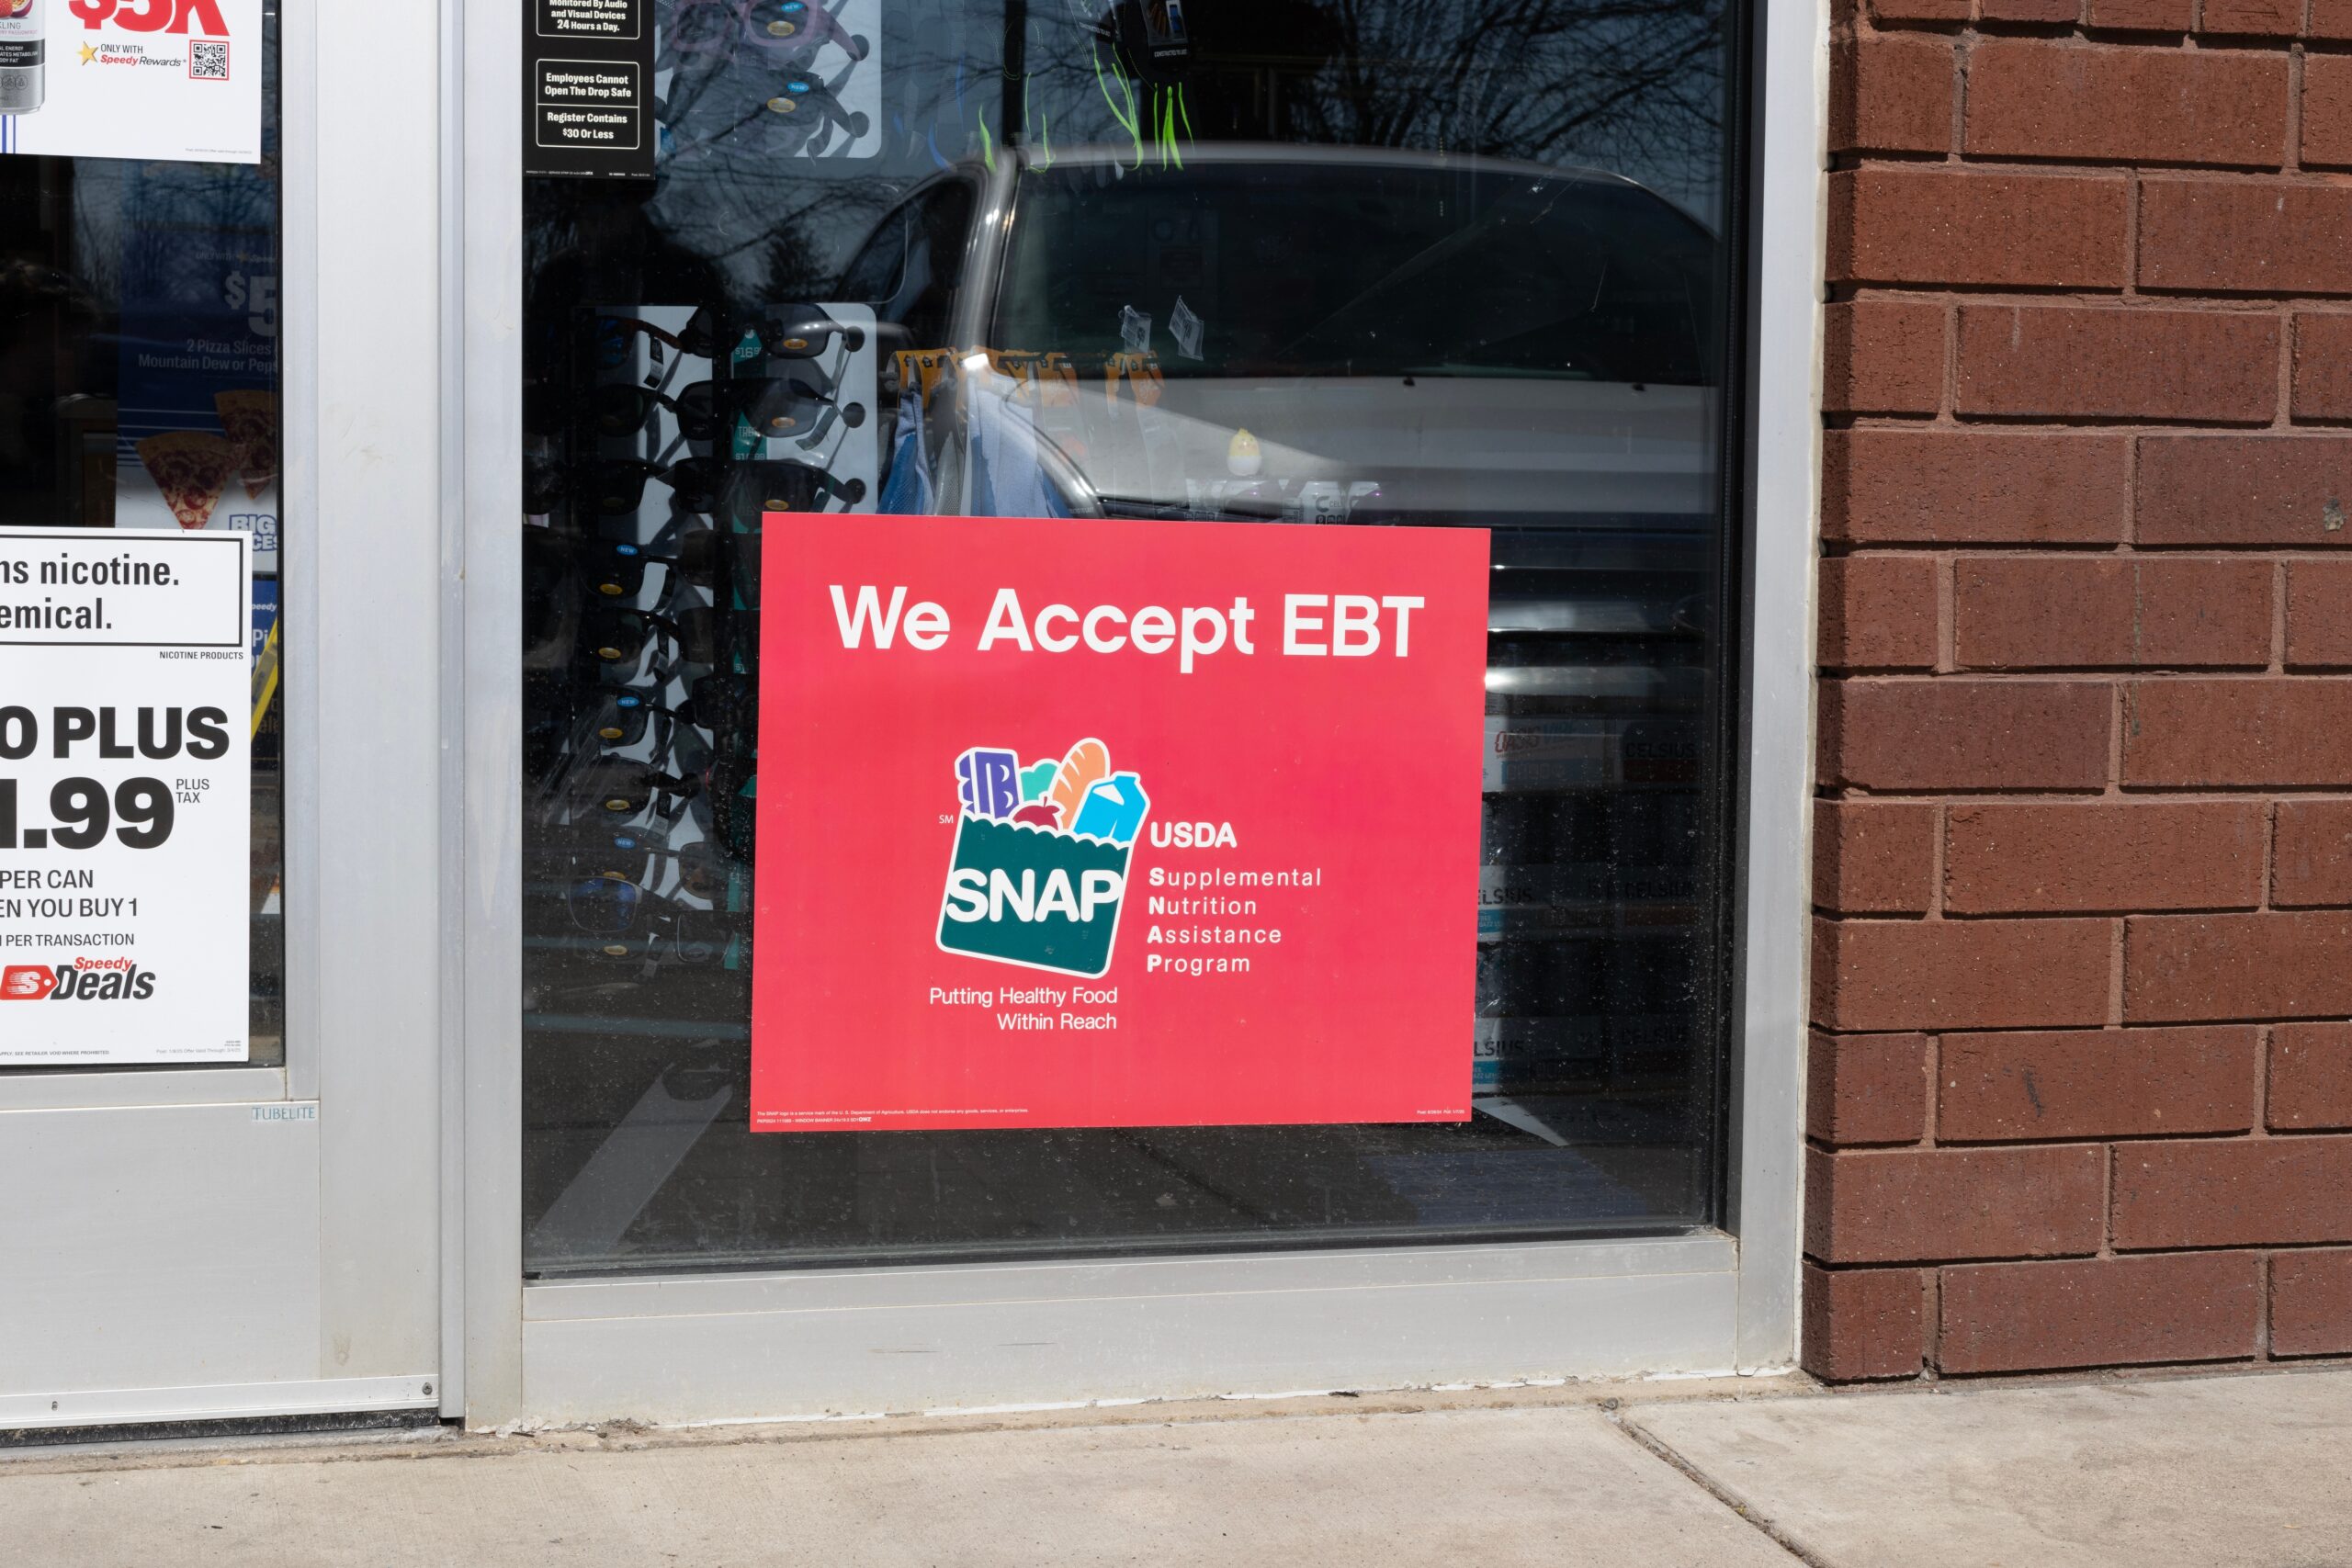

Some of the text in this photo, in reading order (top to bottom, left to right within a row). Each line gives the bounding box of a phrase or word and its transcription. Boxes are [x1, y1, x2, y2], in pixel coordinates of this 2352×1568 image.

[593, 0, 604, 8] By
[605, 0, 628, 8] Audio
[568, 10, 593, 18] Visual
[594, 11, 626, 20] Devices
[557, 19, 570, 29] 24
[571, 22, 595, 30] Hours
[603, 23, 620, 32] Day.
[101, 44, 143, 54] ONLY WITH
[101, 55, 138, 67] Speedy
[546, 73, 628, 85] Employees Cannot
[545, 85, 632, 98] Open The Drop Safe
[547, 112, 628, 124] Register Contains
[562, 128, 614, 139] $30 Or Less
[187, 339, 271, 355] 2 Pizza Slices
[139, 354, 199, 369] Mountain
[202, 356, 230, 370] Dew
[232, 360, 245, 371] or
[230, 514, 277, 533] BIG
[40, 552, 179, 586] nicotine.
[0, 597, 112, 629] emical.
[830, 584, 1425, 674] We Accept EBT
[159, 651, 243, 660] NICOTINE PRODUCTS
[53, 706, 230, 760] PLUS
[175, 779, 210, 791] PLUS
[175, 792, 201, 804] TAX
[939, 814, 1238, 848] SM USDA
[0, 869, 94, 889] PER CAN
[1148, 867, 1322, 890] Supplemental
[945, 868, 1124, 922] SNAP
[27, 898, 73, 918] YOU
[79, 898, 124, 917] BUY
[129, 897, 138, 917] 1
[1148, 896, 1257, 915] Nutrition
[6, 934, 32, 946] PER
[35, 933, 135, 946] TRANSACTION
[1148, 924, 1283, 943] Assistance
[74, 956, 133, 972] Speedy
[1148, 953, 1250, 976] Program
[50, 964, 156, 1000] Deals
[930, 987, 1117, 1008] Putting Healthy Food
[997, 1012, 1117, 1030] Within Reach
[252, 1107, 315, 1120] TUBELITE
